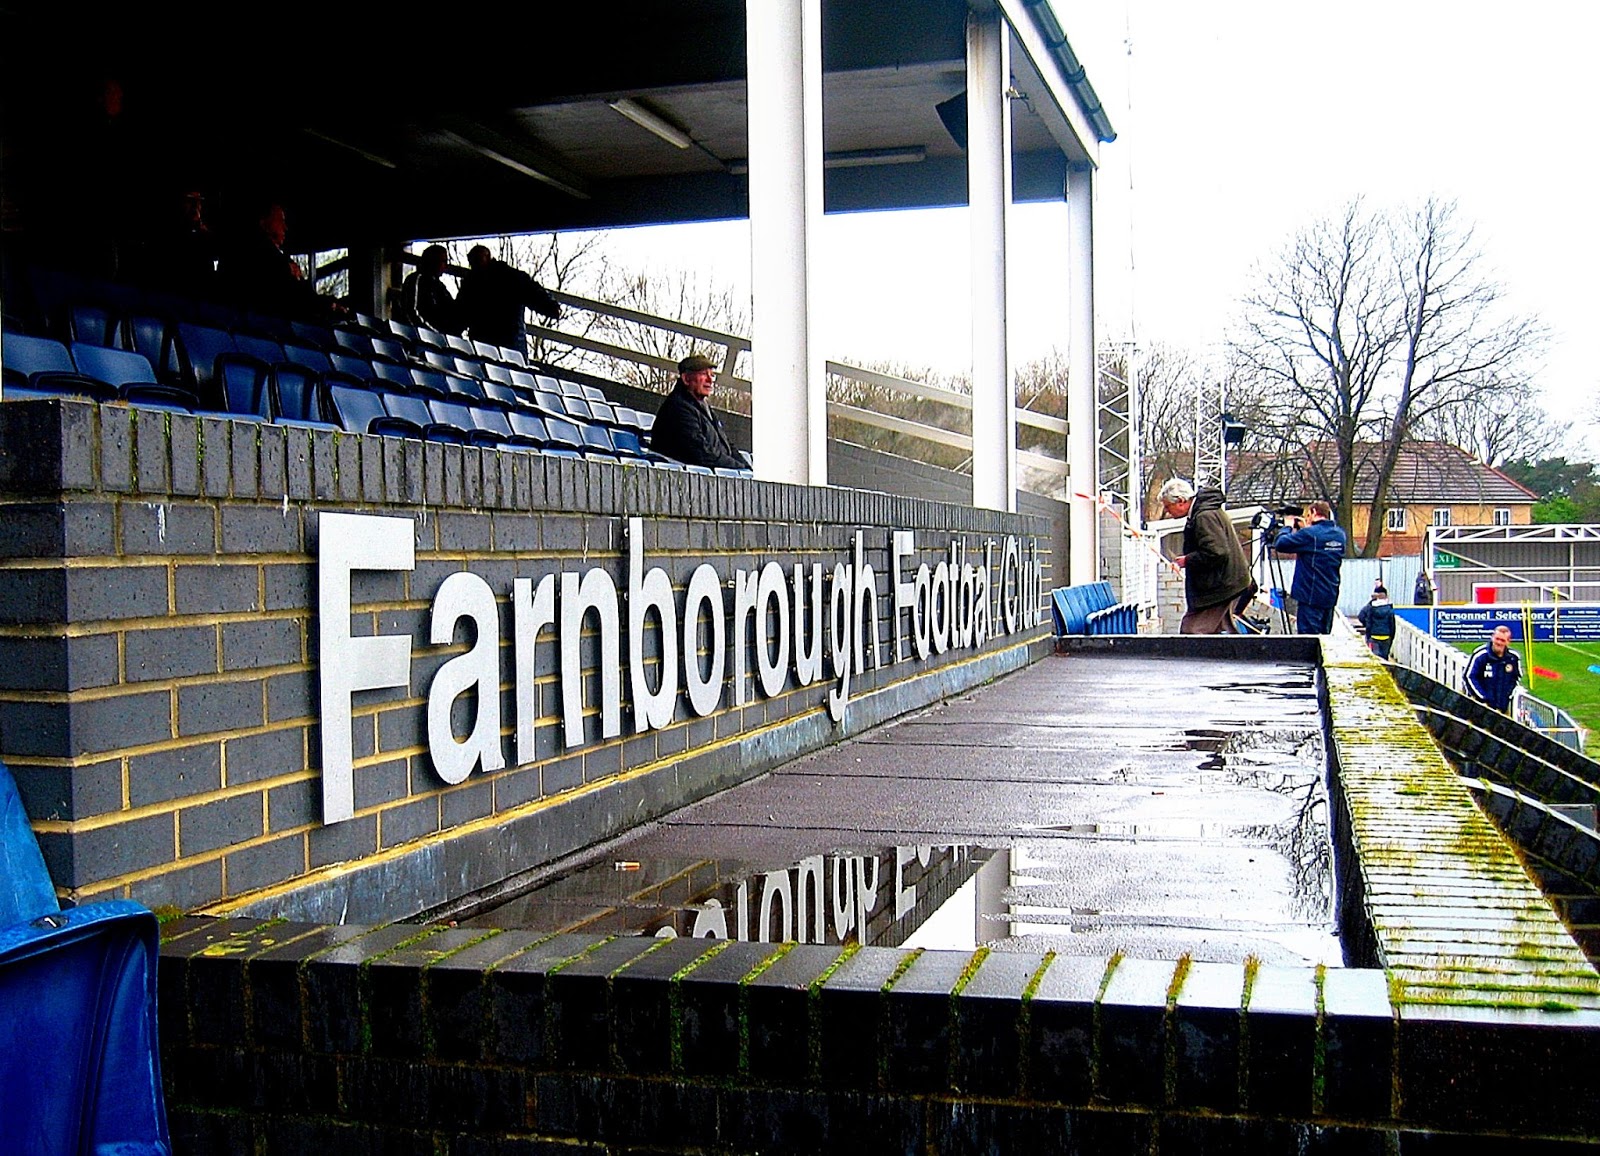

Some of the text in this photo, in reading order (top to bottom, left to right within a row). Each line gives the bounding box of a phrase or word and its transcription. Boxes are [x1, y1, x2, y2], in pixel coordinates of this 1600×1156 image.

[1433, 554, 1455, 563] EXIT
[1437, 611, 1544, 620] Personnel Selecon
[318, 511, 1043, 825] Farnborough Football Club
